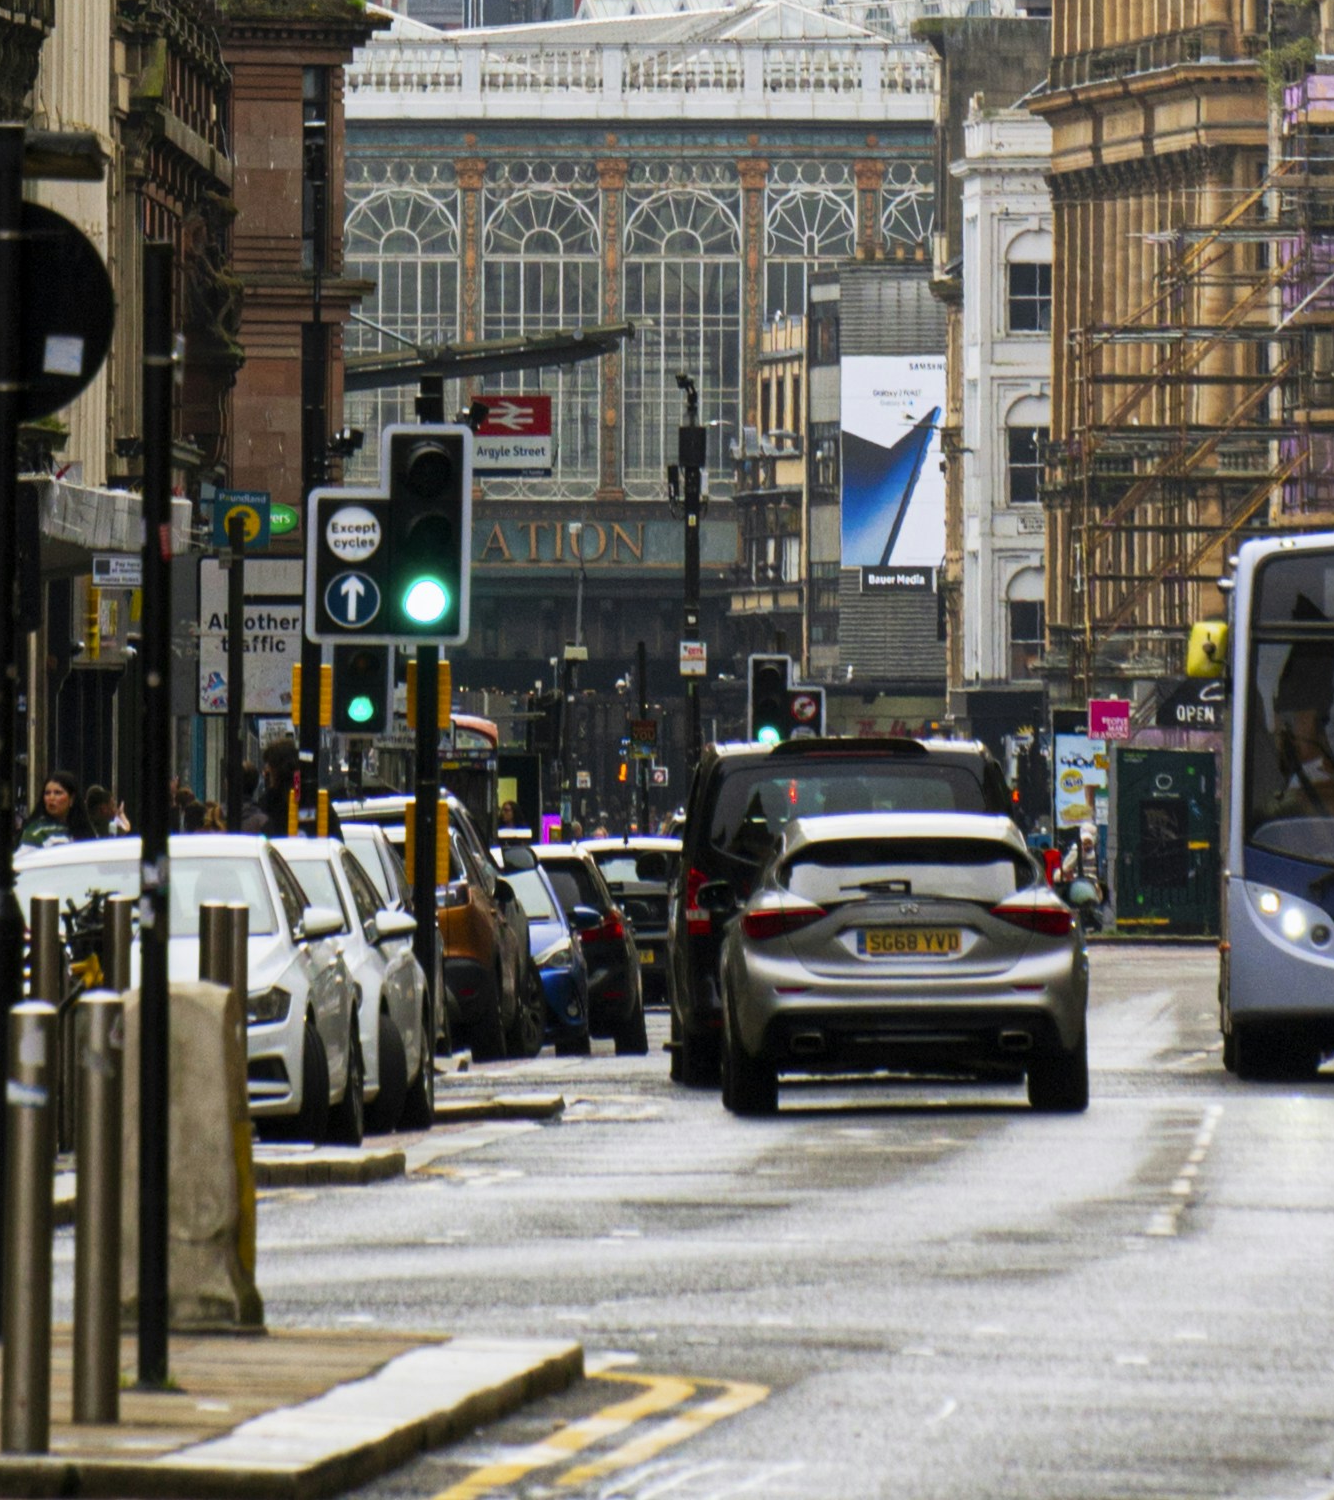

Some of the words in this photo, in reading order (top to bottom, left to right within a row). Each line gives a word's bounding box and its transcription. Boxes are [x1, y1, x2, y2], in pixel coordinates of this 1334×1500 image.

[476, 445, 511, 463] Argyle
[513, 445, 546, 457] Street
[218, 492, 266, 504] Poundland
[270, 512, 291, 524] ers
[331, 521, 377, 537] Except
[333, 536, 376, 550] cycles
[471, 521, 646, 562] ATION
[867, 574, 896, 586] Bauer
[897, 573, 926, 586] Media
[244, 612, 300, 632] other
[1176, 703, 1216, 724] OPEN
[869, 932, 918, 952] SG68
[922, 932, 961, 951] YVD
